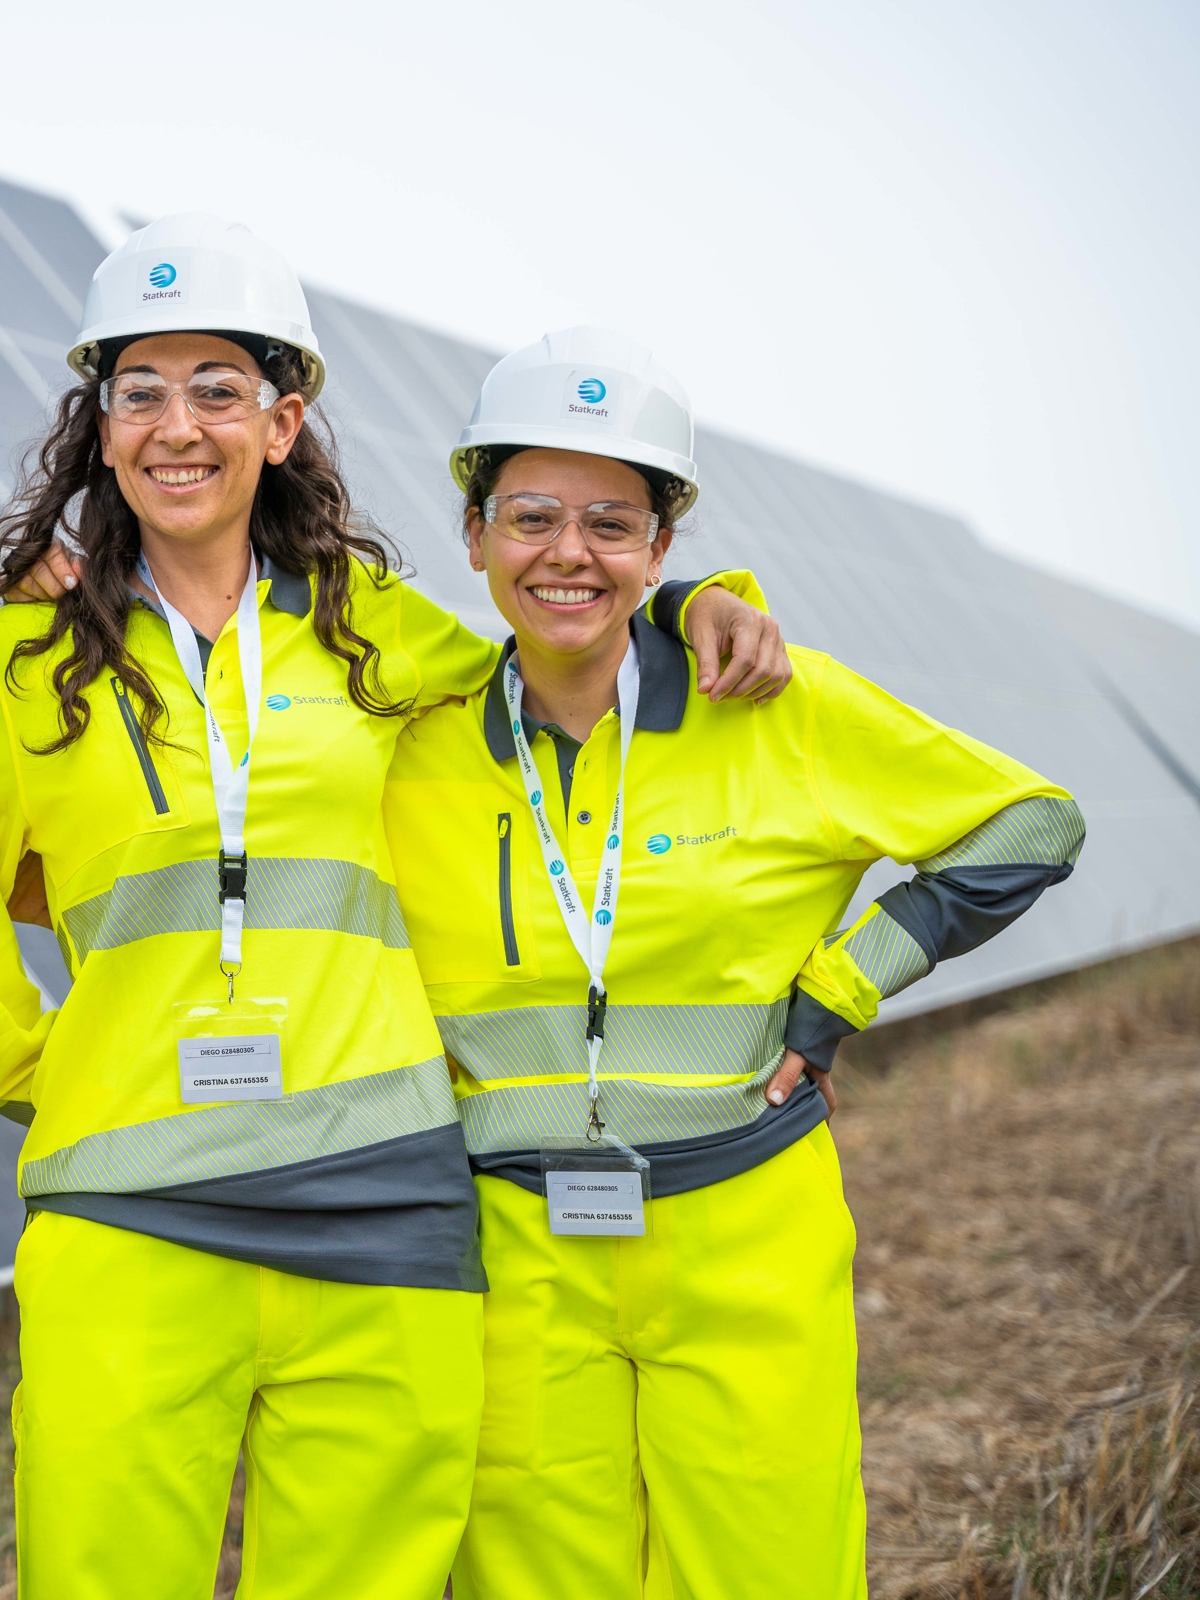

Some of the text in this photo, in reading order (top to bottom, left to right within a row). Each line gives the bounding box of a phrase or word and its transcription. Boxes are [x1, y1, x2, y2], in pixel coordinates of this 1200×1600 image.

[142, 290, 181, 301] Statkraft
[568, 404, 608, 418] Statkraft
[293, 695, 350, 707] Statkraft
[508, 672, 518, 704] Statkraft
[517, 737, 531, 774] Statkraft
[535, 807, 551, 844] Statkraft
[676, 826, 737, 845] Statkraft
[557, 877, 576, 913] Statkraft
[601, 868, 613, 906] Statkraft
